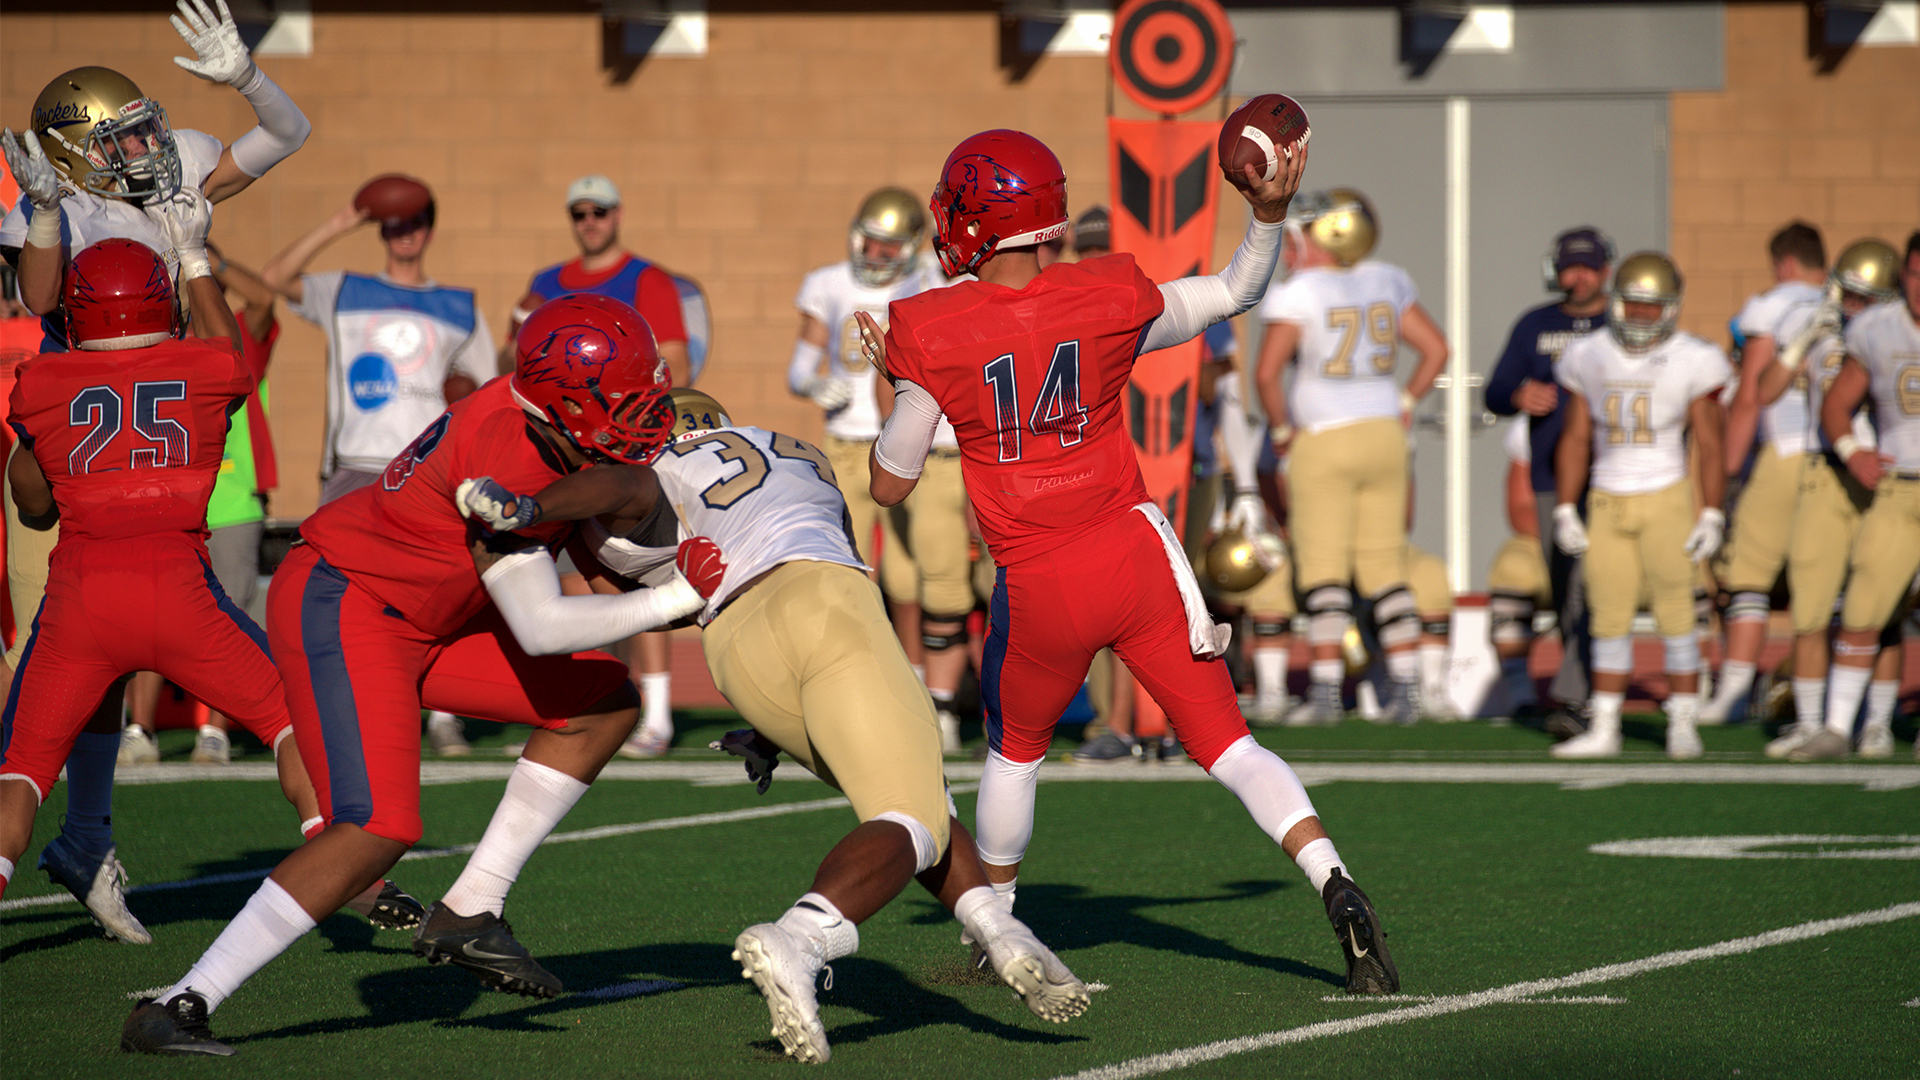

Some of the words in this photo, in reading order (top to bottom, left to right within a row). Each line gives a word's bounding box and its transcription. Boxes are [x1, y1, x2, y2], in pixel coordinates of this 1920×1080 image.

[1324, 301, 1396, 379] 79
[69, 380, 189, 476] 25
[682, 413, 715, 430] 34
[983, 339, 1089, 463] 14
[1601, 391, 1657, 448] 11
[669, 431, 842, 511] 34
